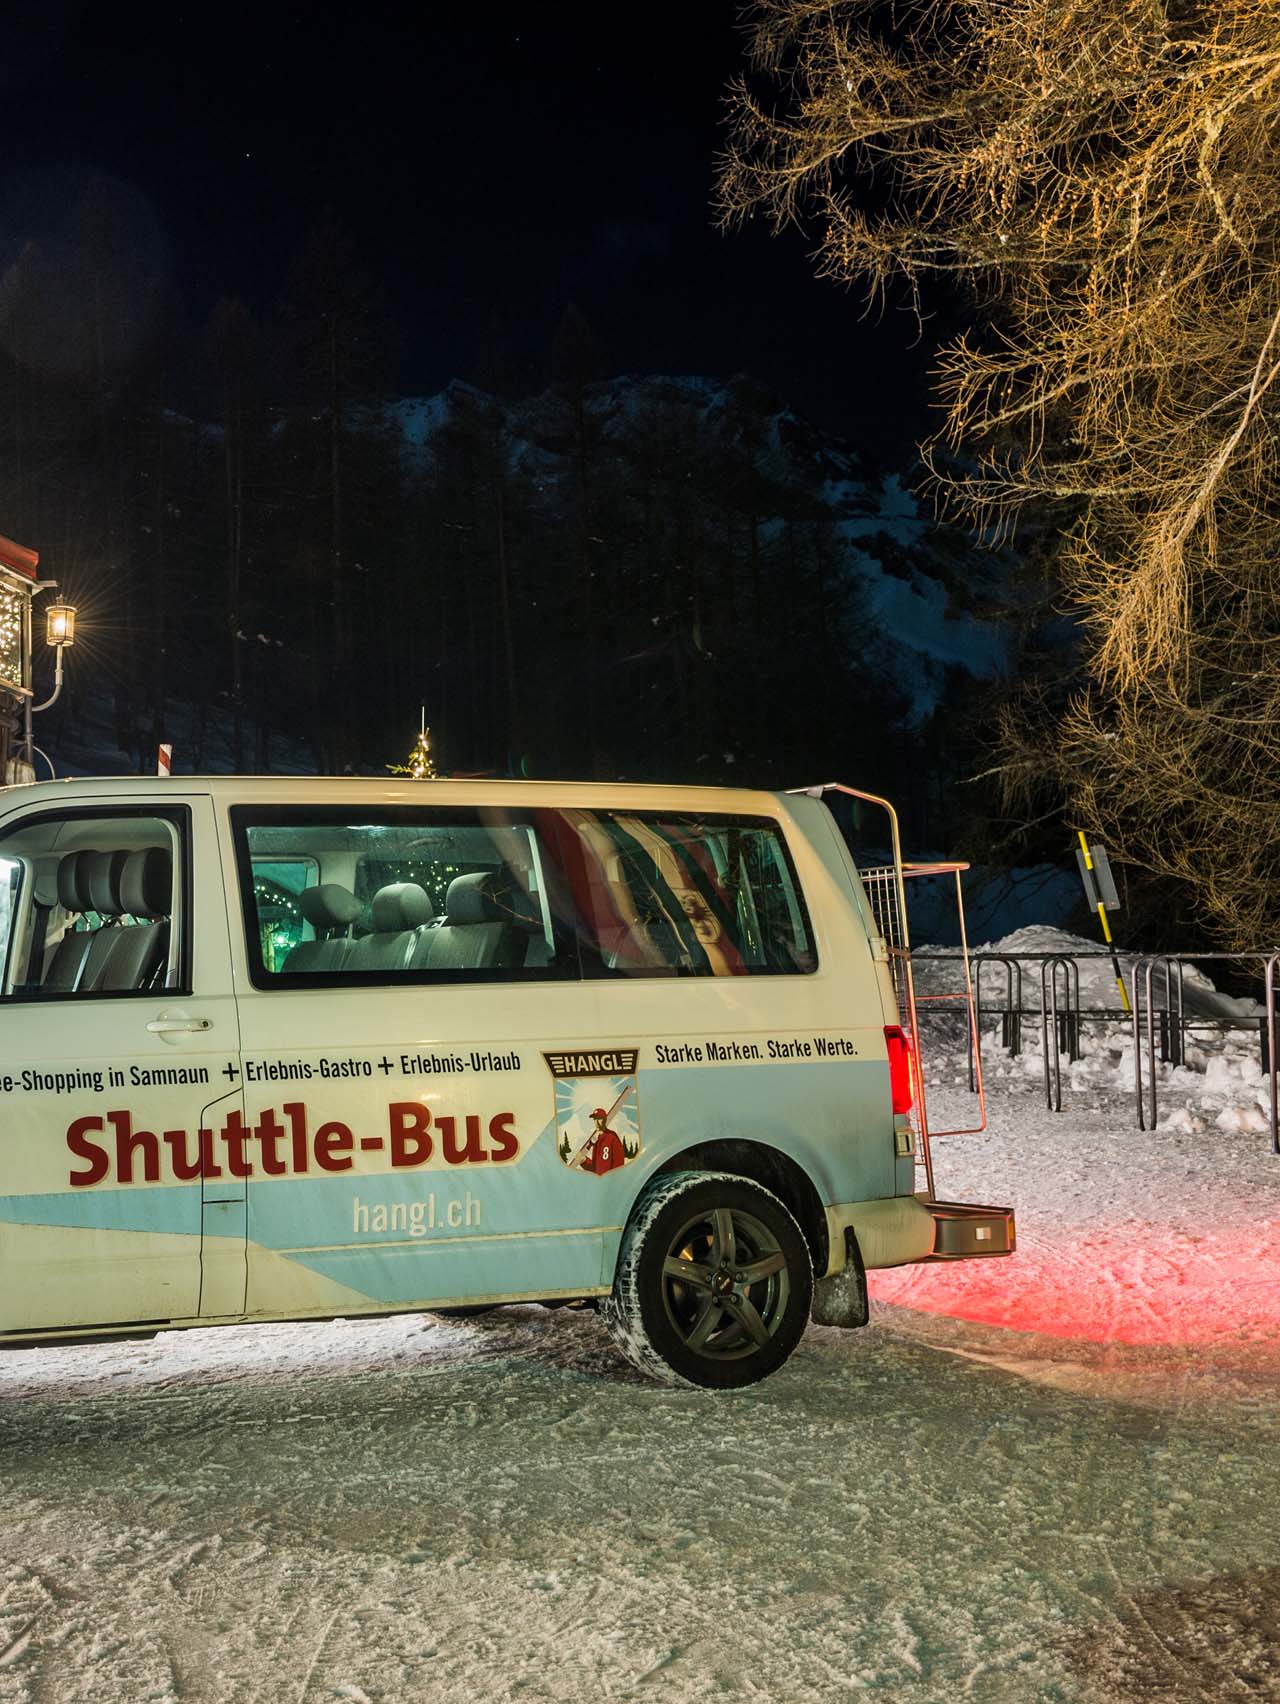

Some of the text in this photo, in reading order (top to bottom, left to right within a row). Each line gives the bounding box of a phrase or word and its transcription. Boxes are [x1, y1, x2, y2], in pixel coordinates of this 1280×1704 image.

[564, 1054, 623, 1073] HANGL
[655, 1036, 859, 1064] Starke Marken. Starke Werte.
[109, 1066, 125, 1087] in
[130, 1064, 209, 1087] Samnaun
[247, 1058, 373, 1082] Erlebnis-Gastro
[400, 1051, 521, 1076] Erlebnis-Urlaub
[66, 1101, 520, 1187] Shuttle-Bus
[352, 1192, 482, 1237] hangl.ch
